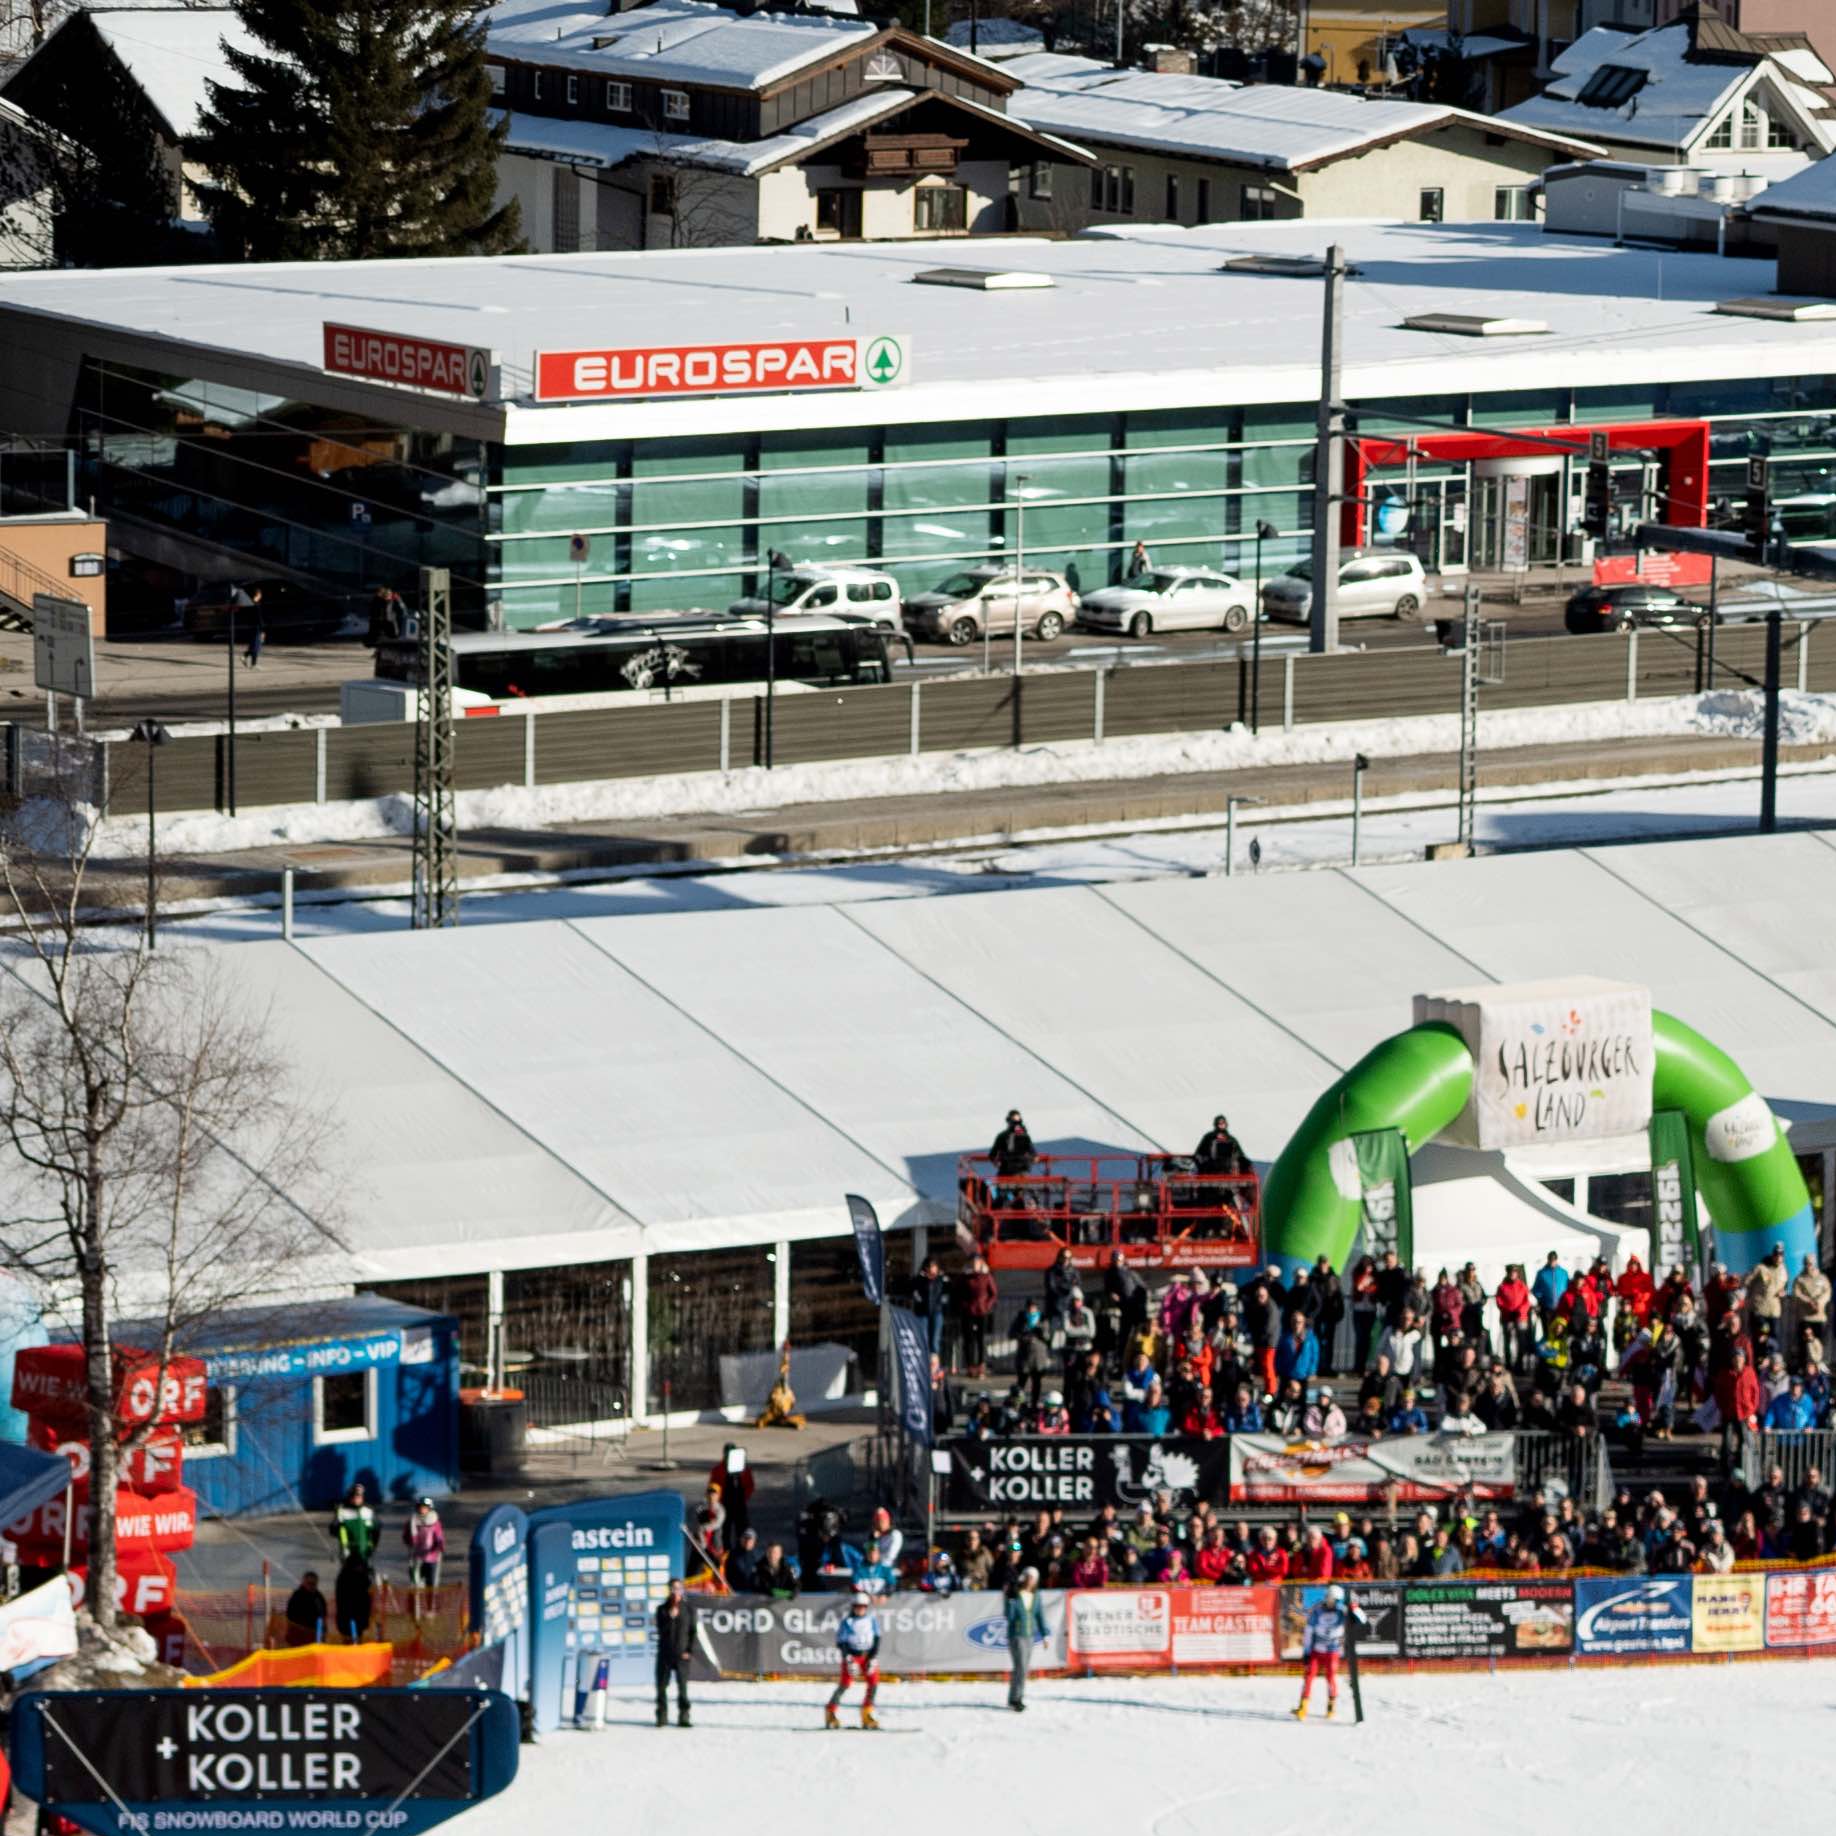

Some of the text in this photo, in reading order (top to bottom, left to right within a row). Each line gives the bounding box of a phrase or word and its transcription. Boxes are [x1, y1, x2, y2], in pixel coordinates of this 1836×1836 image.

[333, 333, 466, 389] EUROSPAR
[573, 344, 856, 392] EUROSPAR
[1498, 1034, 1641, 1098] SALZBURGER
[1534, 1086, 1587, 1132] LAND
[366, 1338, 399, 1362] VIP
[130, 1376, 206, 1418] ORF
[990, 1446, 1095, 1472] KOLLER
[990, 1474, 1095, 1500] KOLLER
[116, 1512, 152, 1539] WIE
[571, 1519, 654, 1550] astein
[697, 1607, 774, 1634] FORD
[1173, 1614, 1273, 1633] TEAM GASTEIN
[1593, 1616, 1637, 1634] Airport
[187, 1703, 361, 1741] KOLLER
[188, 1752, 362, 1791] KOLLER
[118, 1810, 409, 1831] FIS SNOWBOARD WORLD CUP
